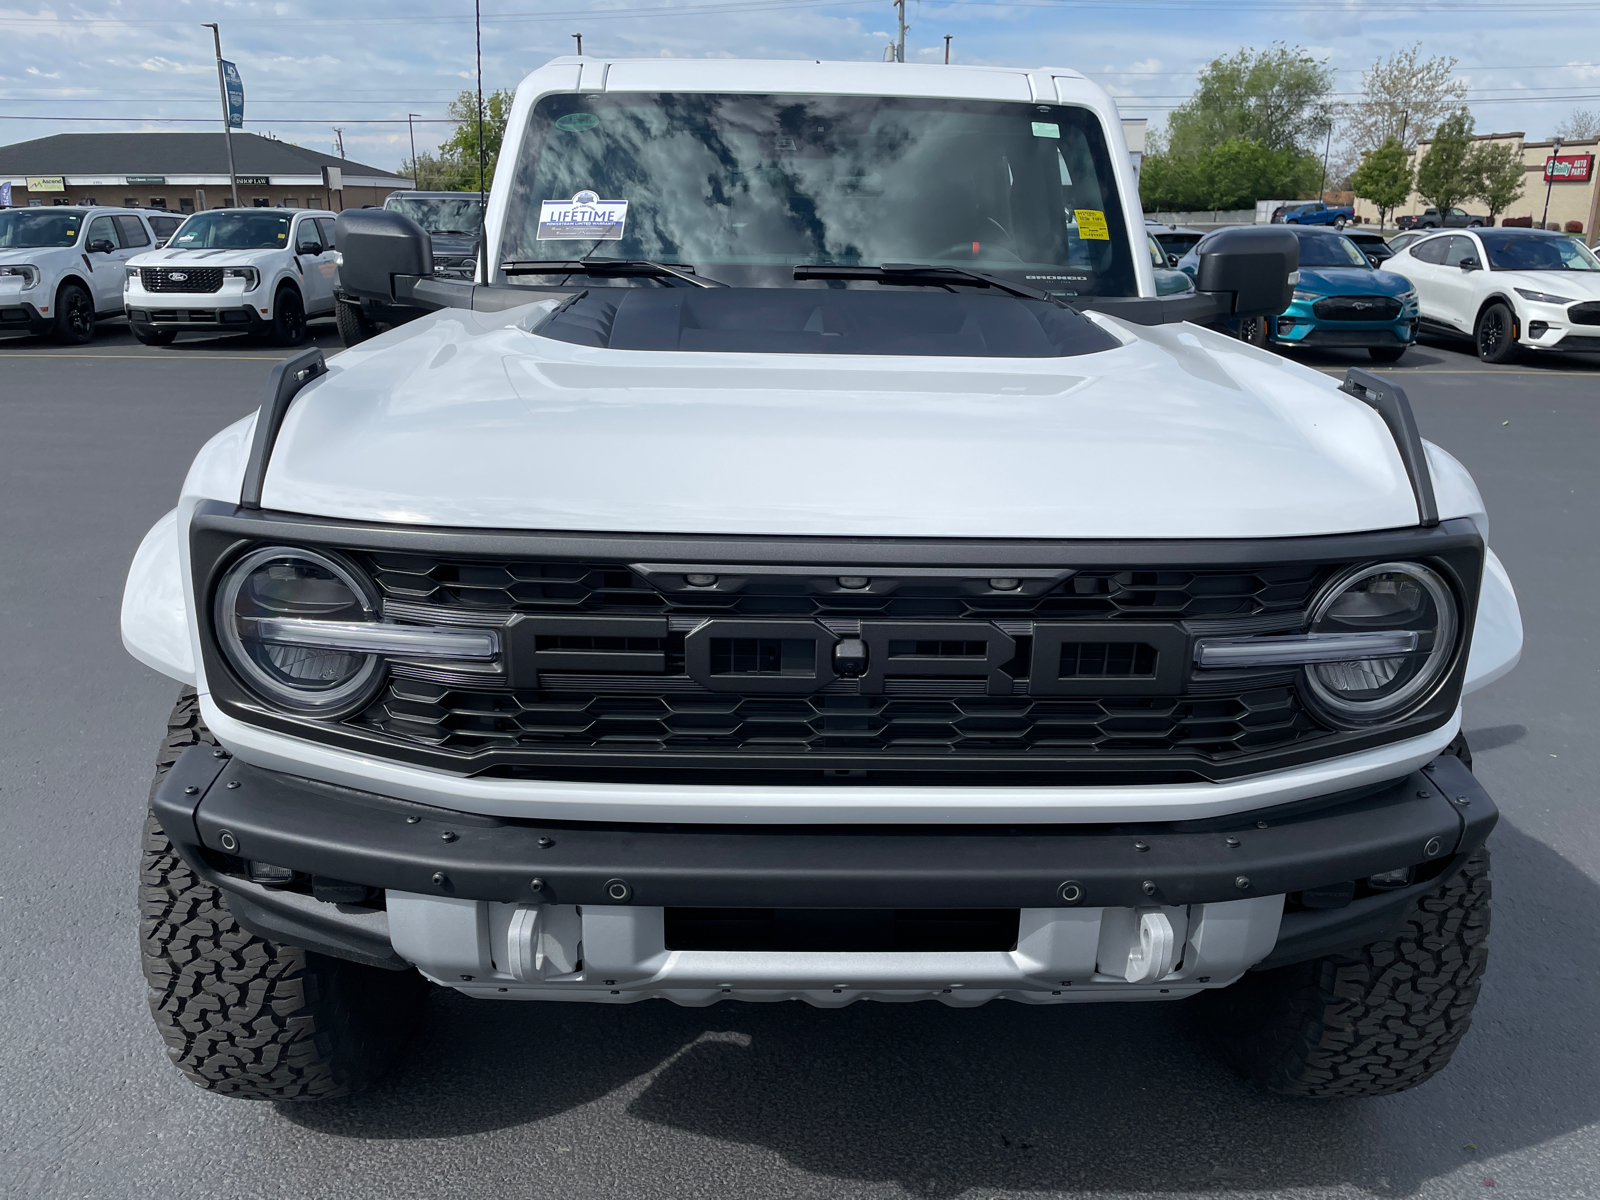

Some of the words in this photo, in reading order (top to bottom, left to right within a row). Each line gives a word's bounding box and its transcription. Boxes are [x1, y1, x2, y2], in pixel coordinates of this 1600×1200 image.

[1574, 159, 1587, 167] AUTO
[550, 210, 615, 222] LIFETIME
[503, 613, 1191, 697] FORD
